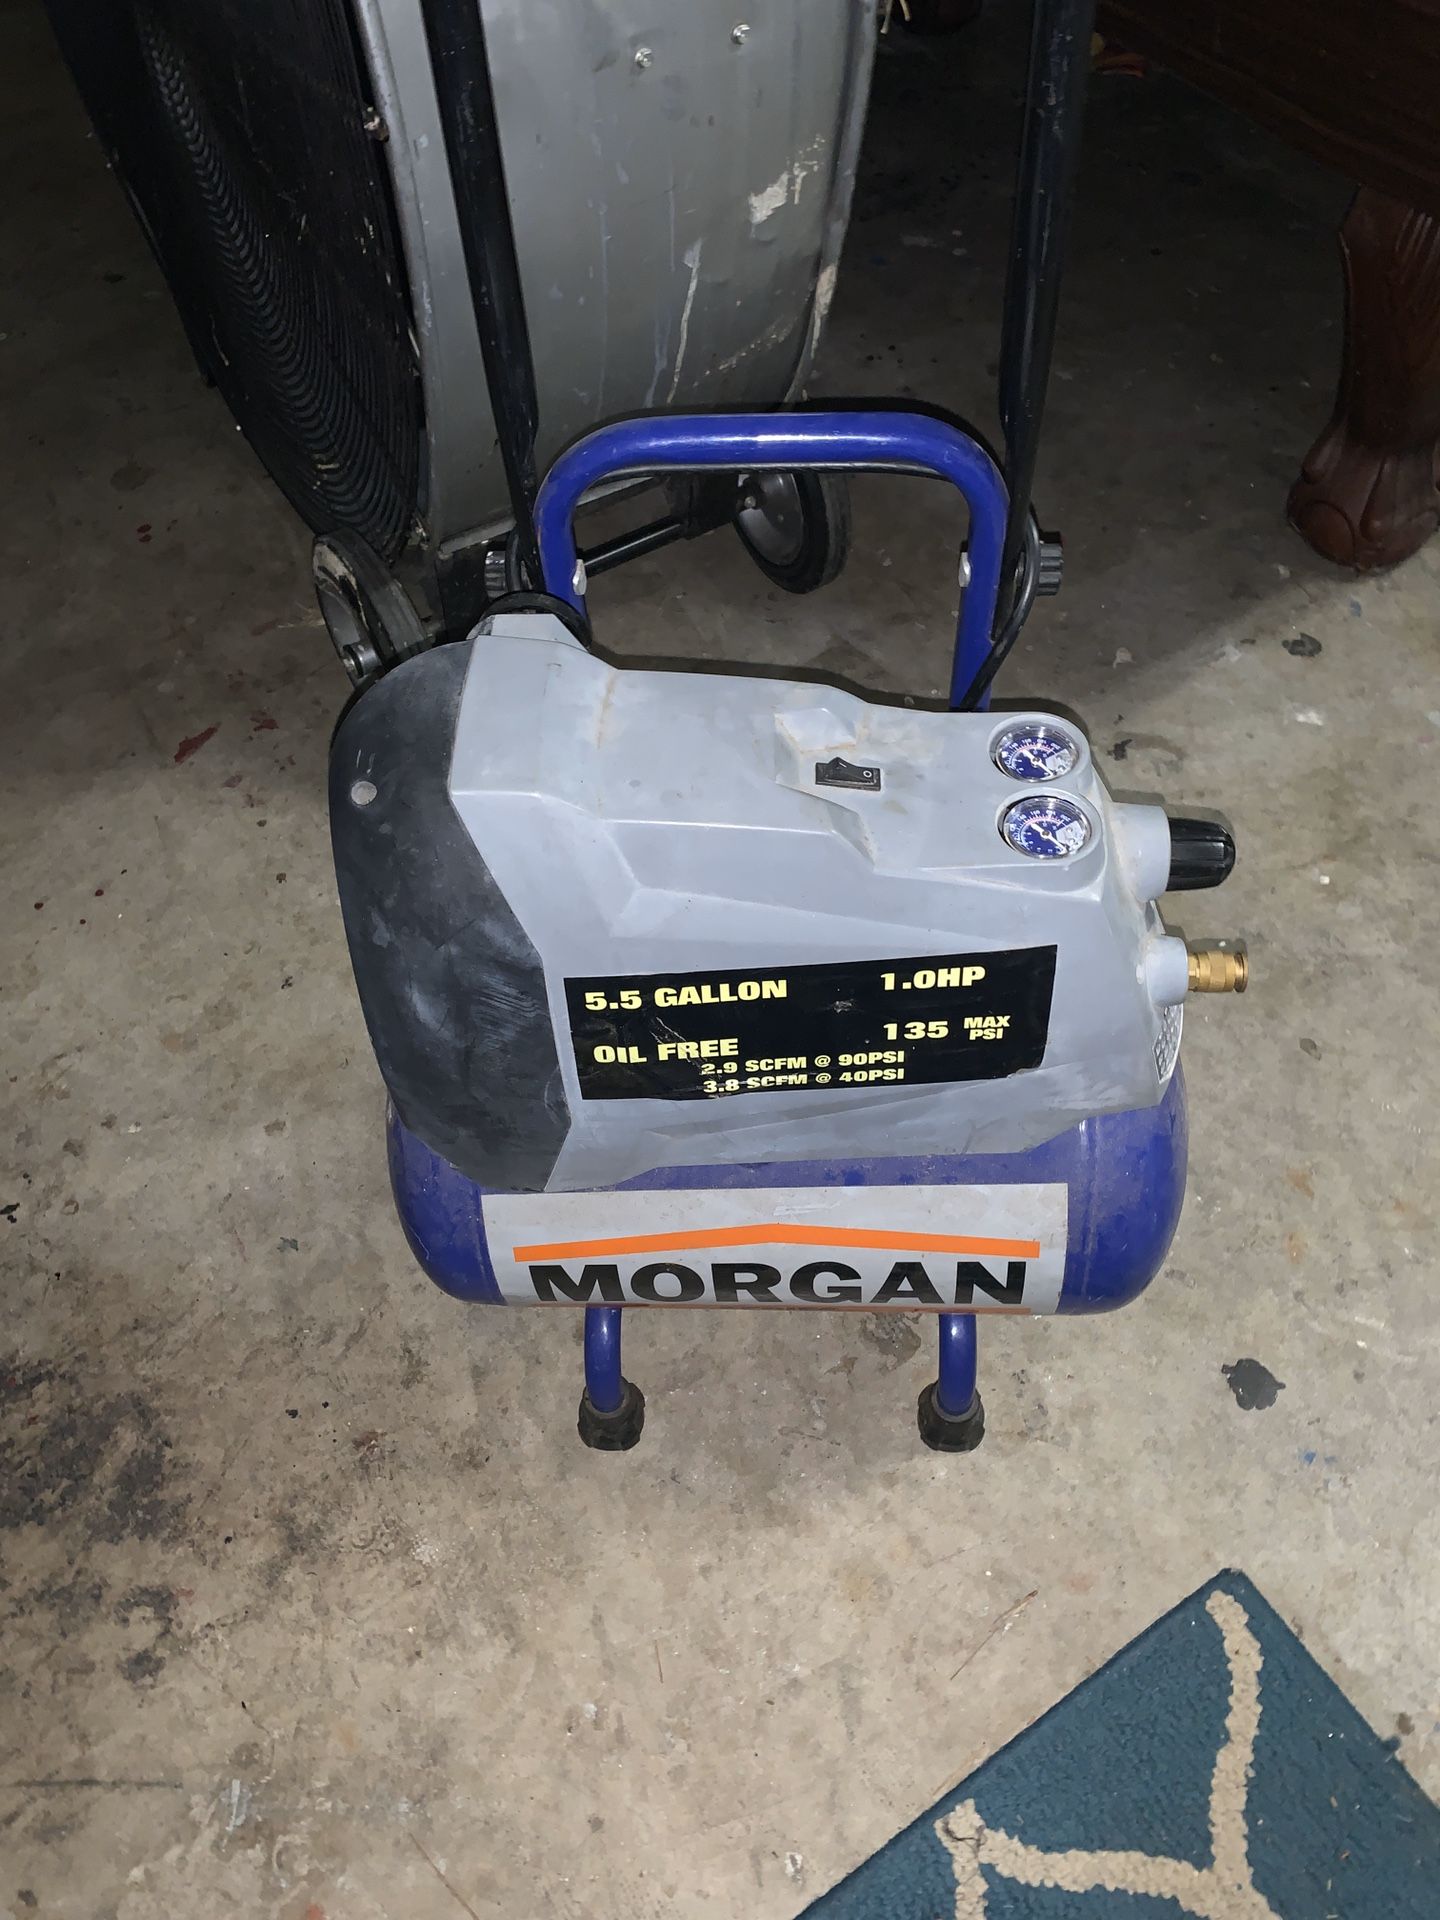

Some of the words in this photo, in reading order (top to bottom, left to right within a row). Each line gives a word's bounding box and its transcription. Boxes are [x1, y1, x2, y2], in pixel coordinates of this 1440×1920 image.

[880, 966, 986, 991] 1.0HP
[584, 990, 642, 1011] 5.5
[654, 979, 787, 1008] GALLON
[883, 1020, 949, 1040] 135
[963, 1015, 1011, 1029] MAX
[969, 1028, 1004, 1041] PSI
[593, 1045, 648, 1064] OIL
[657, 1038, 739, 1061] FREE
[701, 1061, 738, 1075] 2.9
[745, 1056, 807, 1073] SCFM
[814, 1055, 831, 1068] @
[838, 1050, 905, 1066] 90PSI
[703, 1078, 740, 1094] 3.8
[746, 1074, 808, 1089] SCFM
[815, 1072, 832, 1083] @
[838, 1068, 905, 1082] 40PSI
[528, 1260, 1027, 1305] MORGAN
